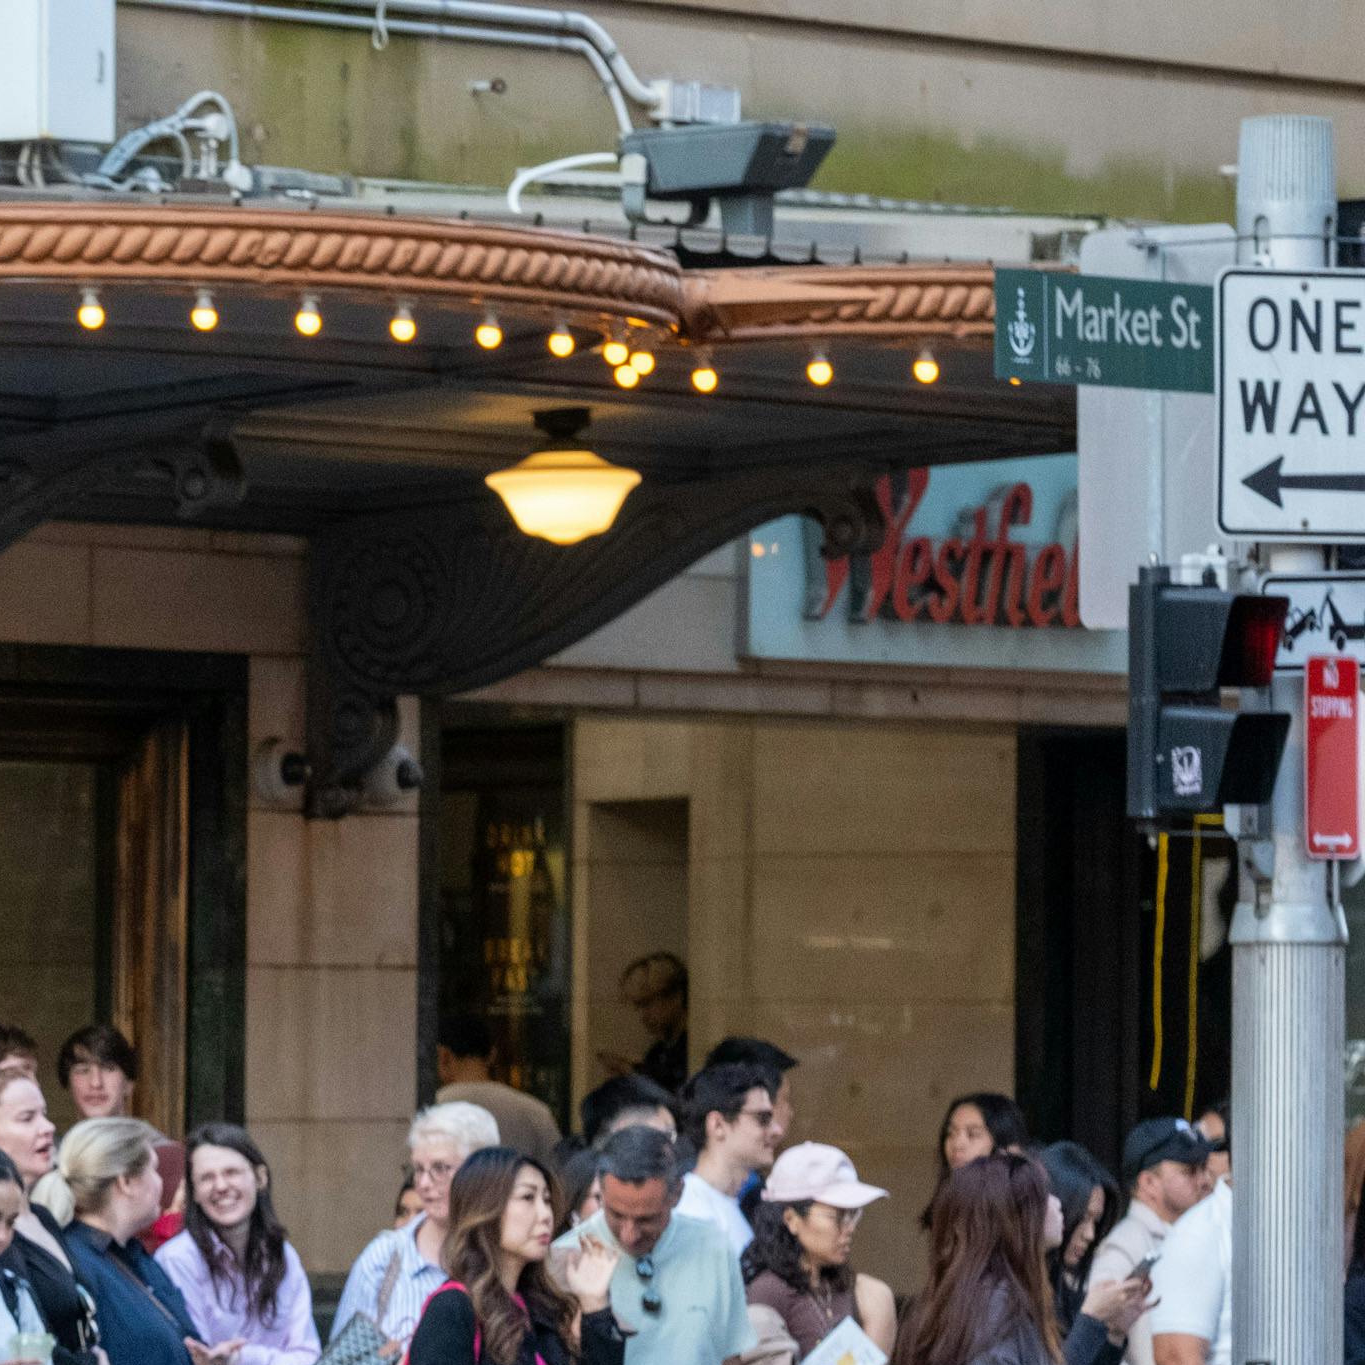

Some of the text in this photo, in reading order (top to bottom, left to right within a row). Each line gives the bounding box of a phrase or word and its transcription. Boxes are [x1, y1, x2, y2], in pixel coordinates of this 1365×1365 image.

[1055, 286, 1202, 349] Market St
[1248, 297, 1363, 354] ONE
[1238, 379, 1365, 436] WAY
[1310, 695, 1354, 718] STOPPING
